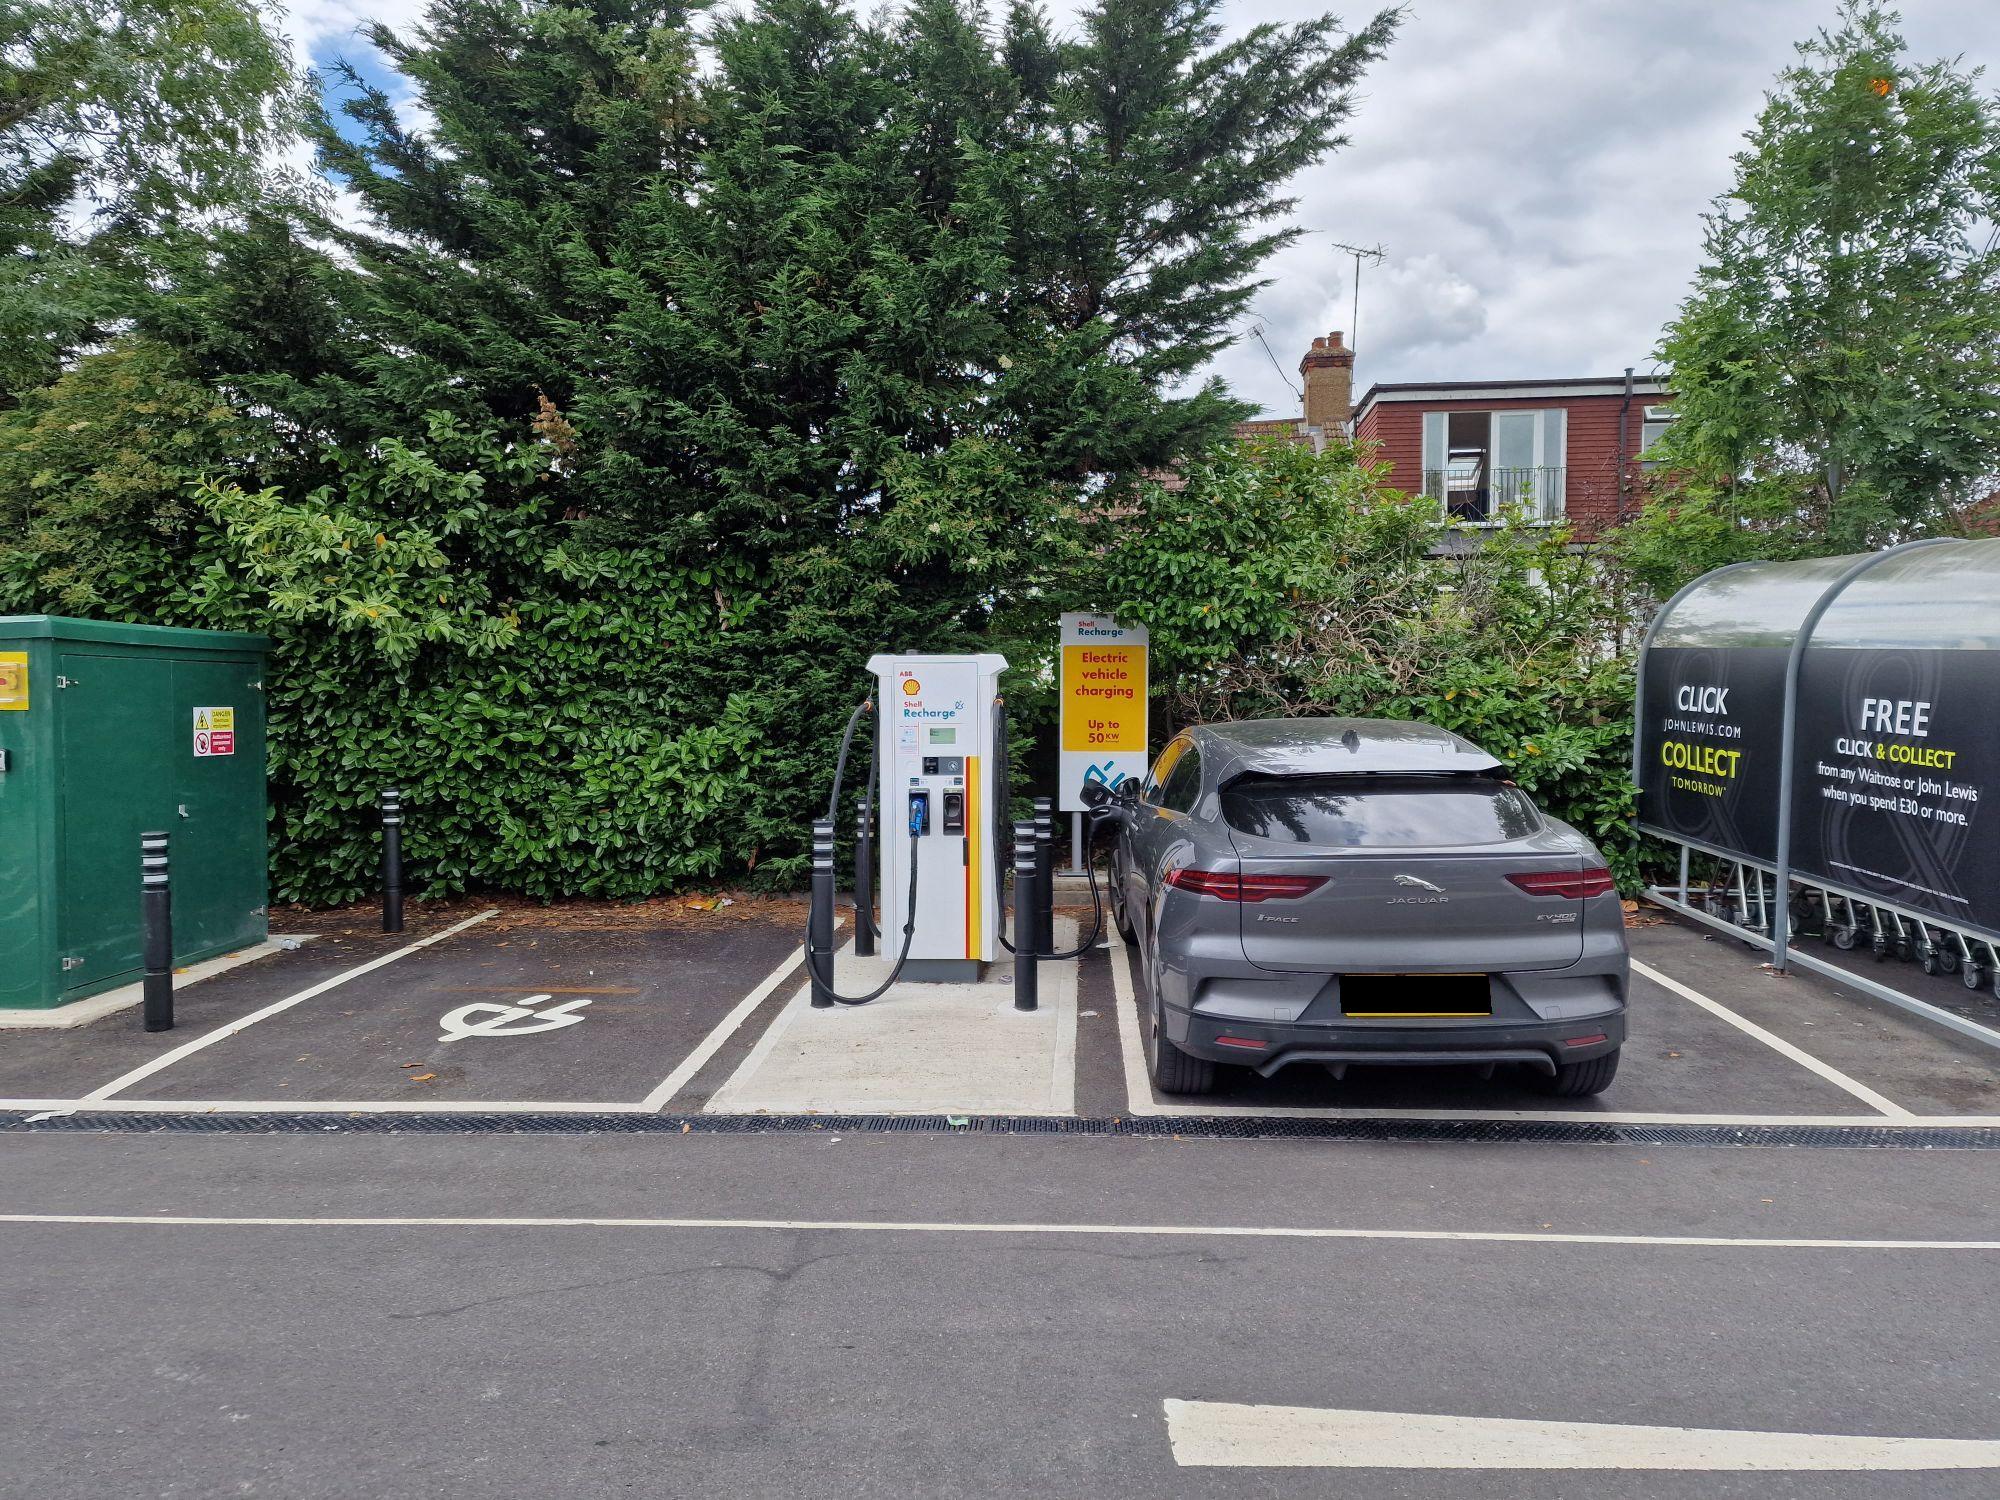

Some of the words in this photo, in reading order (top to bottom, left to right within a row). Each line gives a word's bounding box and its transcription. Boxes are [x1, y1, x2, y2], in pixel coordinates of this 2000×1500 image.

[1078, 627, 1124, 638] Recharge
[1082, 652, 1128, 663] Electric
[1082, 668, 1128, 680] vehicle
[1075, 684, 1134, 699] charging
[1678, 685, 1729, 715] CLICK
[903, 708, 956, 720] Recharge
[1861, 698, 1931, 737] FREE
[1088, 719, 1104, 731] Up
[1108, 720, 1120, 729] to
[1664, 718, 1741, 739] JOHNLEWIS.COM
[1088, 732, 1105, 743] 50
[1662, 741, 1741, 779] COLLECT
[1836, 738, 1873, 759] CLICK
[1876, 743, 1886, 760] &
[1889, 744, 1956, 770] COLLECT
[1818, 761, 1838, 777] from
[1840, 768, 1856, 784] any
[1858, 767, 1901, 788] Waitrose
[1903, 779, 1916, 790] or
[1917, 777, 1942, 797] John
[1945, 781, 1978, 802] Lewis
[1823, 785, 1848, 802] when
[1850, 793, 1867, 807] you
[1869, 796, 1897, 812] spend
[1900, 799, 1918, 816] £30
[1921, 807, 1933, 819] or
[1936, 811, 1968, 827] more.
